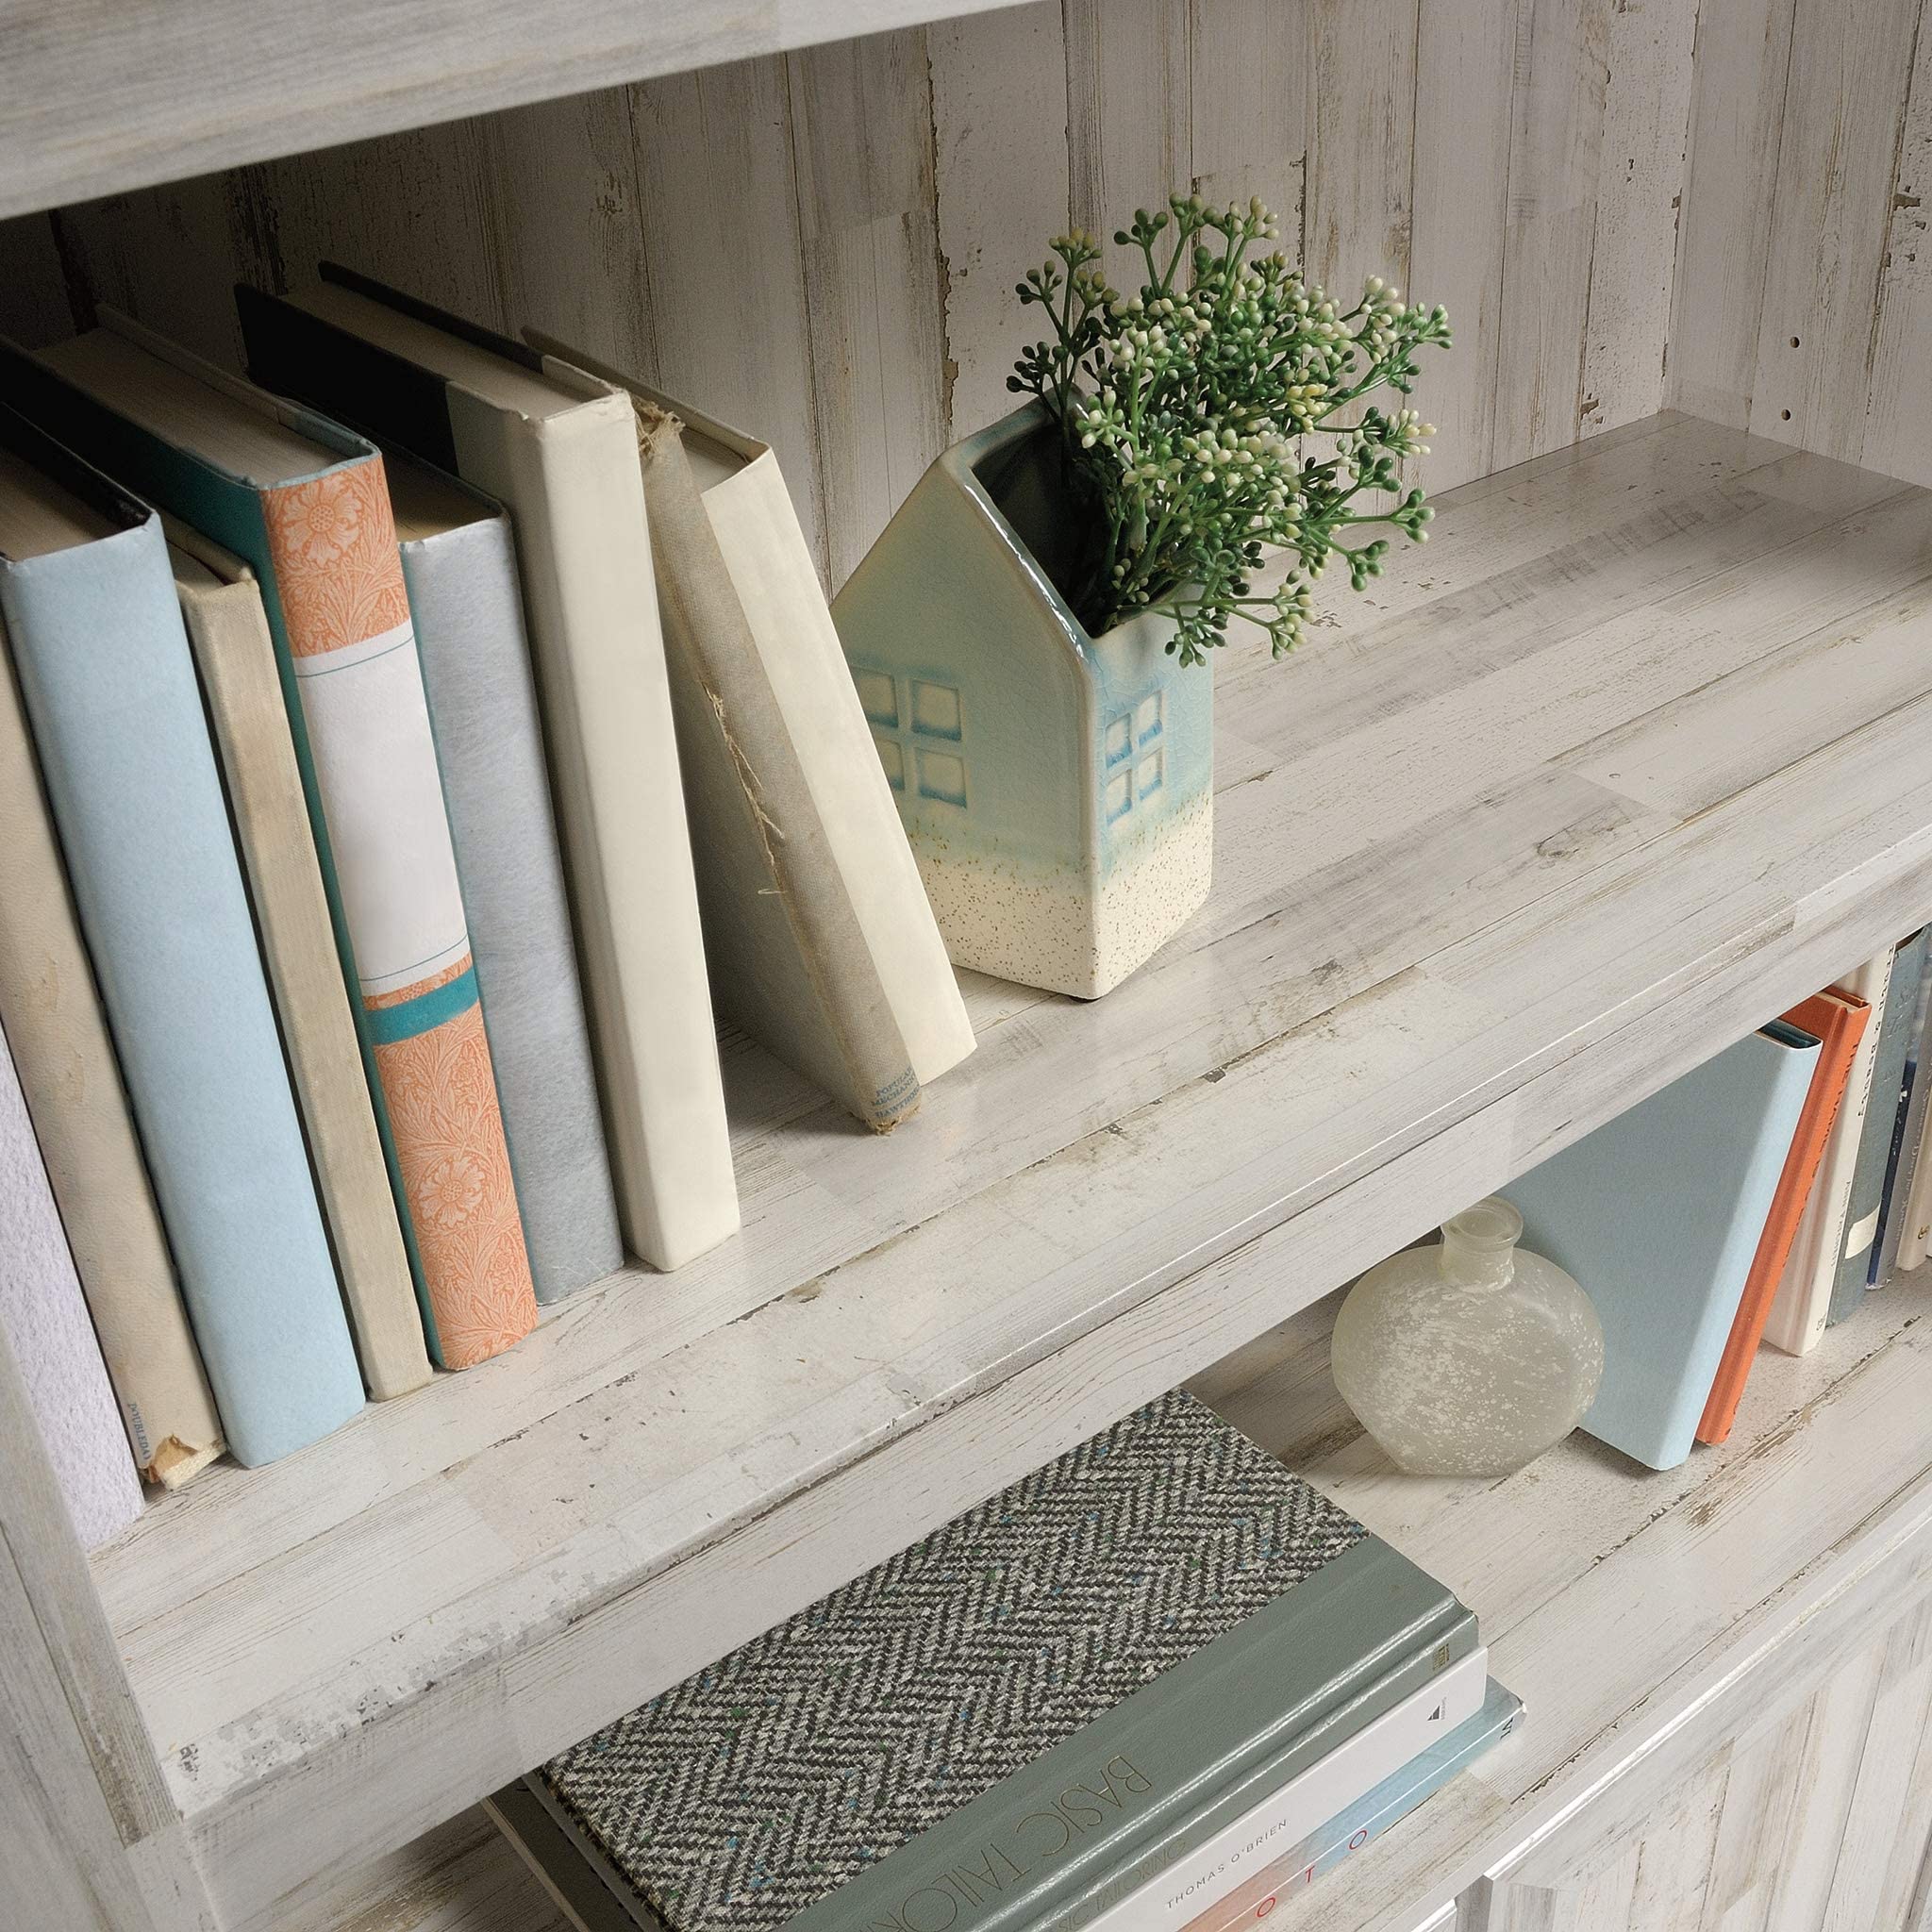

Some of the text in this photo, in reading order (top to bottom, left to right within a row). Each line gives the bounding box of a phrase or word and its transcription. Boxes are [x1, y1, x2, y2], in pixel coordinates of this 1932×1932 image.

[858, 1756, 1153, 1932] BASIC TAILOR
[1165, 1819, 1289, 1909] THOMAS O'BRIEN
